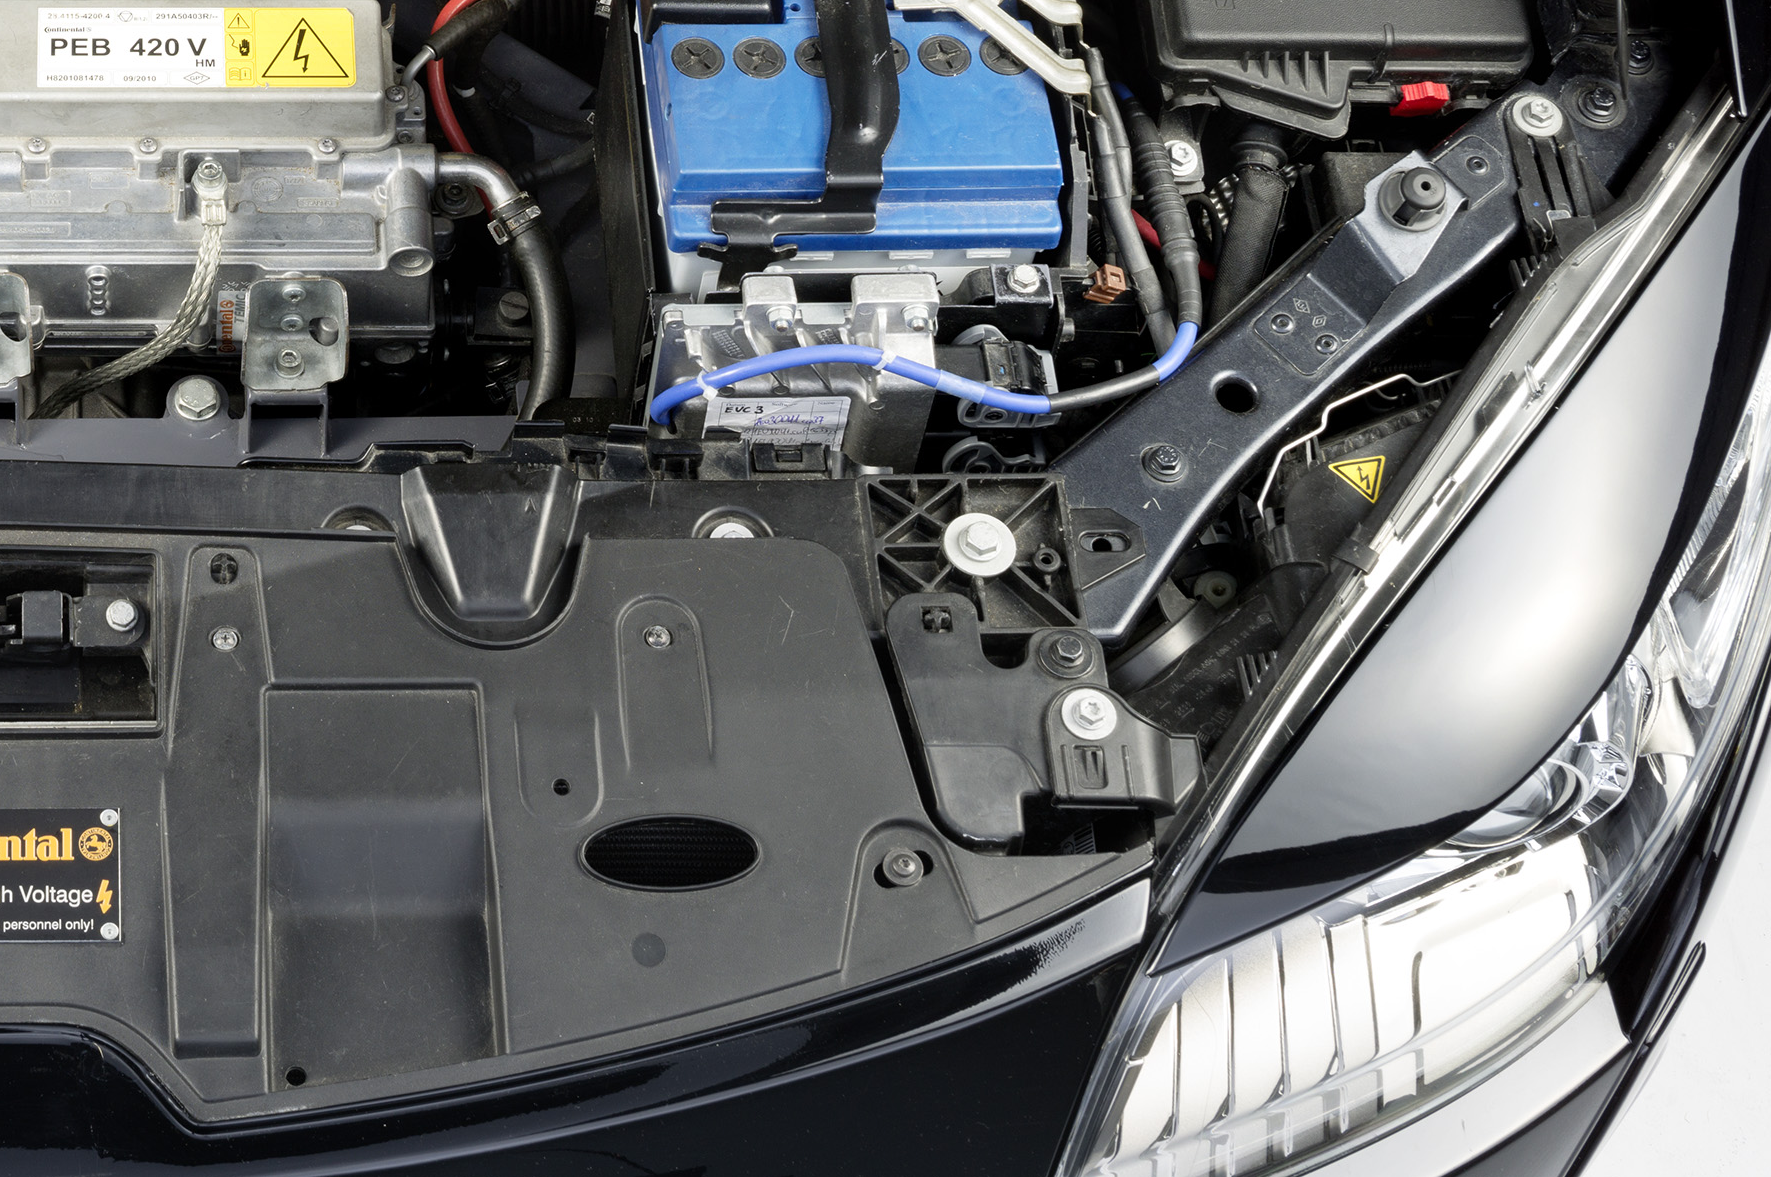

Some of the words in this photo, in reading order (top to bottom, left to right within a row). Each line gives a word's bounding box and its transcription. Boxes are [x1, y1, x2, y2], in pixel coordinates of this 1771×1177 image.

[50, 38, 111, 56] PEB
[129, 38, 180, 56] 420
[187, 38, 207, 56] V
[195, 59, 216, 67] HM
[234, 294, 245, 323] TEMIC
[725, 406, 751, 414] EVC
[754, 406, 764, 414] 3
[19, 885, 93, 908] Voltage
[3, 919, 62, 932] personnel
[65, 919, 94, 933] only!
